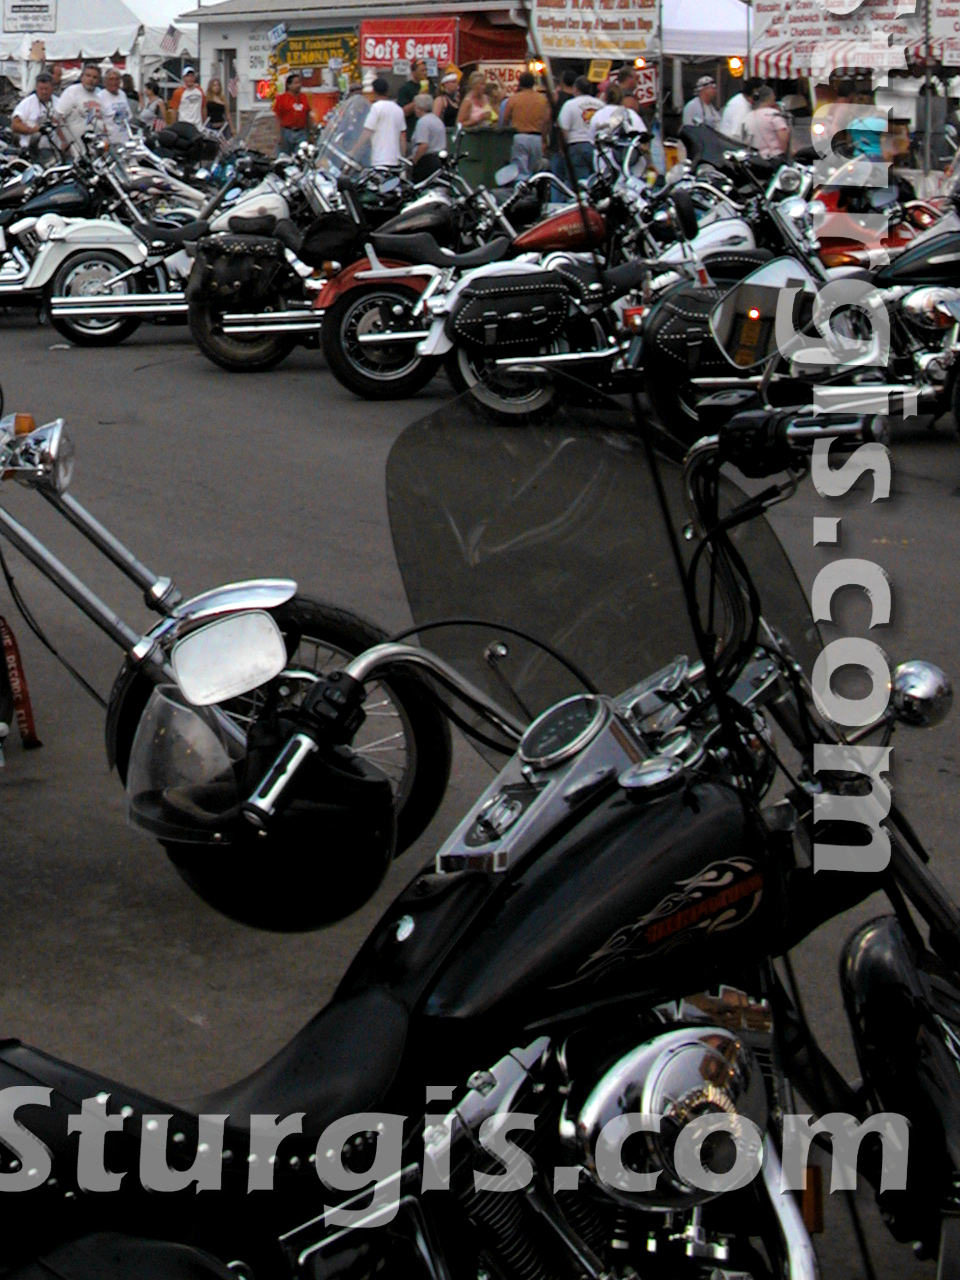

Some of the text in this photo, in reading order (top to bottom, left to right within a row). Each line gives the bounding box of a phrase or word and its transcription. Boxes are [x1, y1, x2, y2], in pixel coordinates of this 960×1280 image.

[826, 26, 841, 36] Milk
[289, 38, 342, 51] Old Fashioned
[364, 37, 449, 60] Soft Serve
[286, 49, 345, 65] LEMONADE
